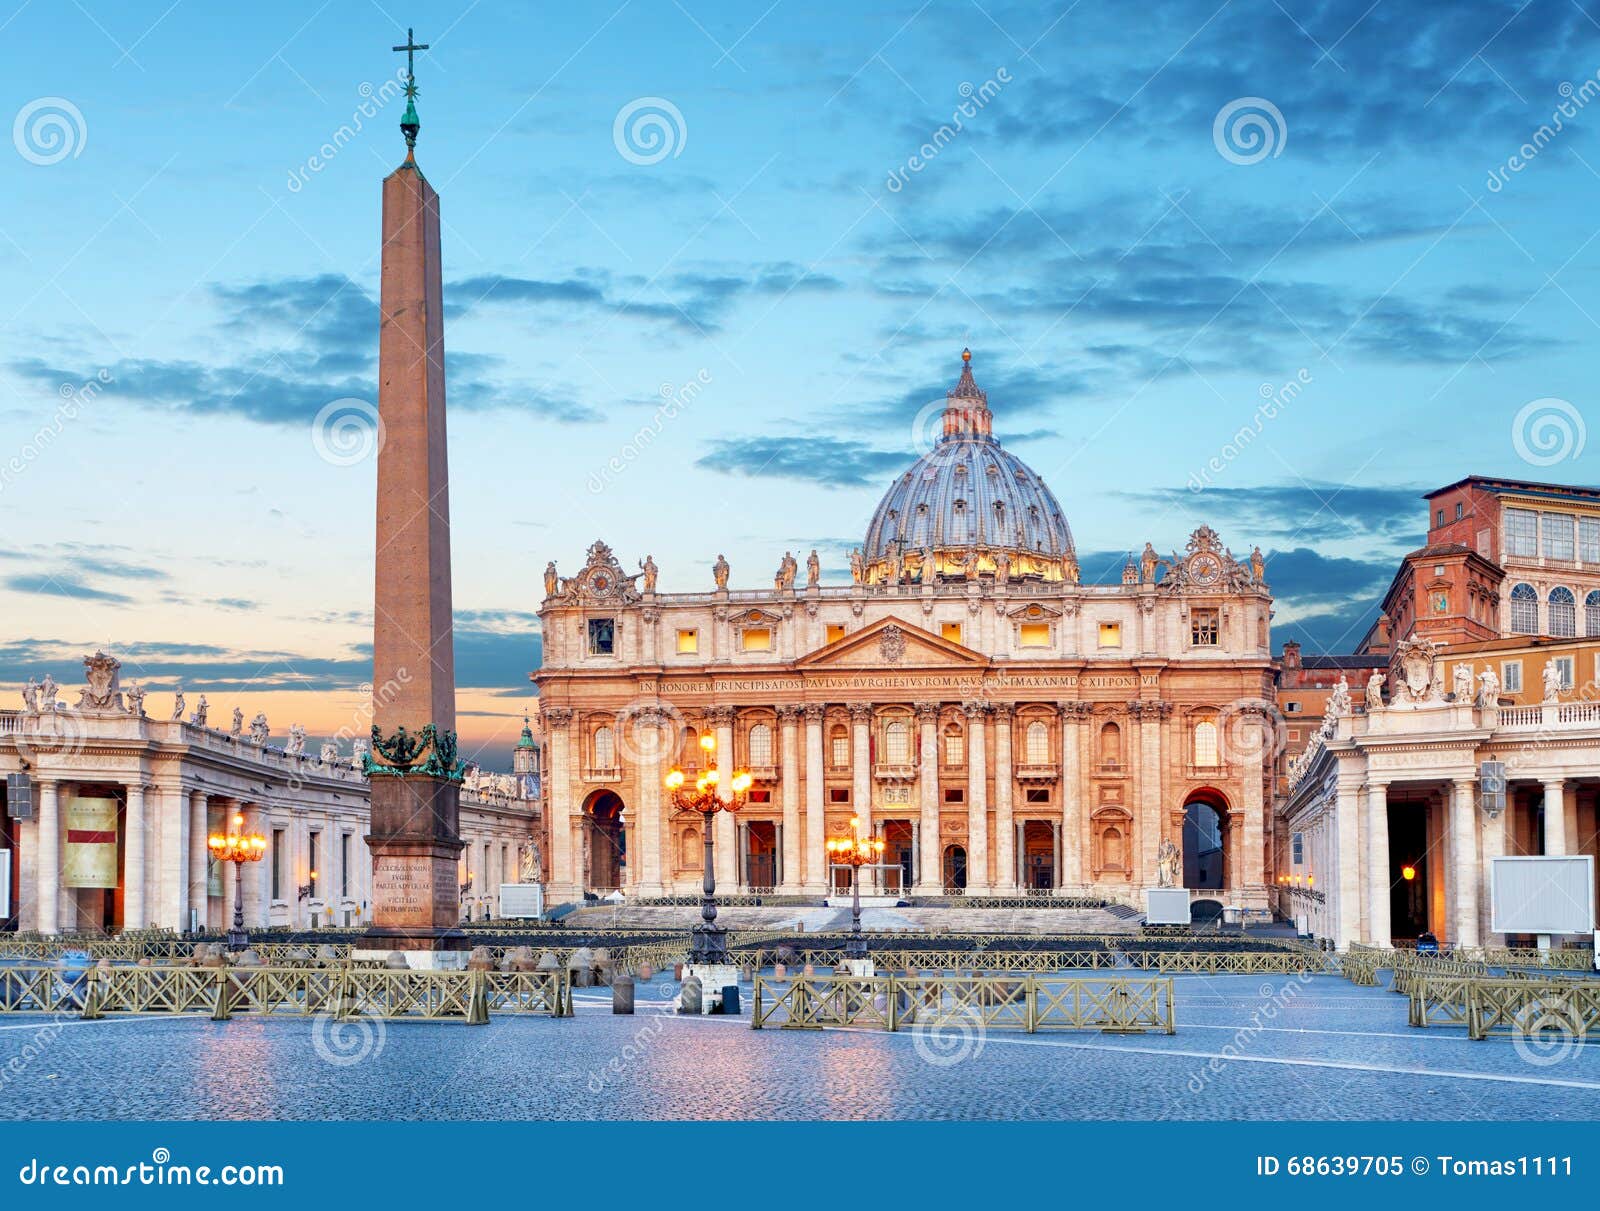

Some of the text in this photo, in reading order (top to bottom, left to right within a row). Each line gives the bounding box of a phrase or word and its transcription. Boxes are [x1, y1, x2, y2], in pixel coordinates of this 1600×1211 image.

[639, 680, 653, 691] IN
[659, 681, 714, 692] HONOREM
[853, 678, 922, 688] BVRGHESIVS
[925, 677, 983, 687] ROMANVS
[1109, 676, 1138, 687] PONT
[1142, 675, 1158, 685] VII
